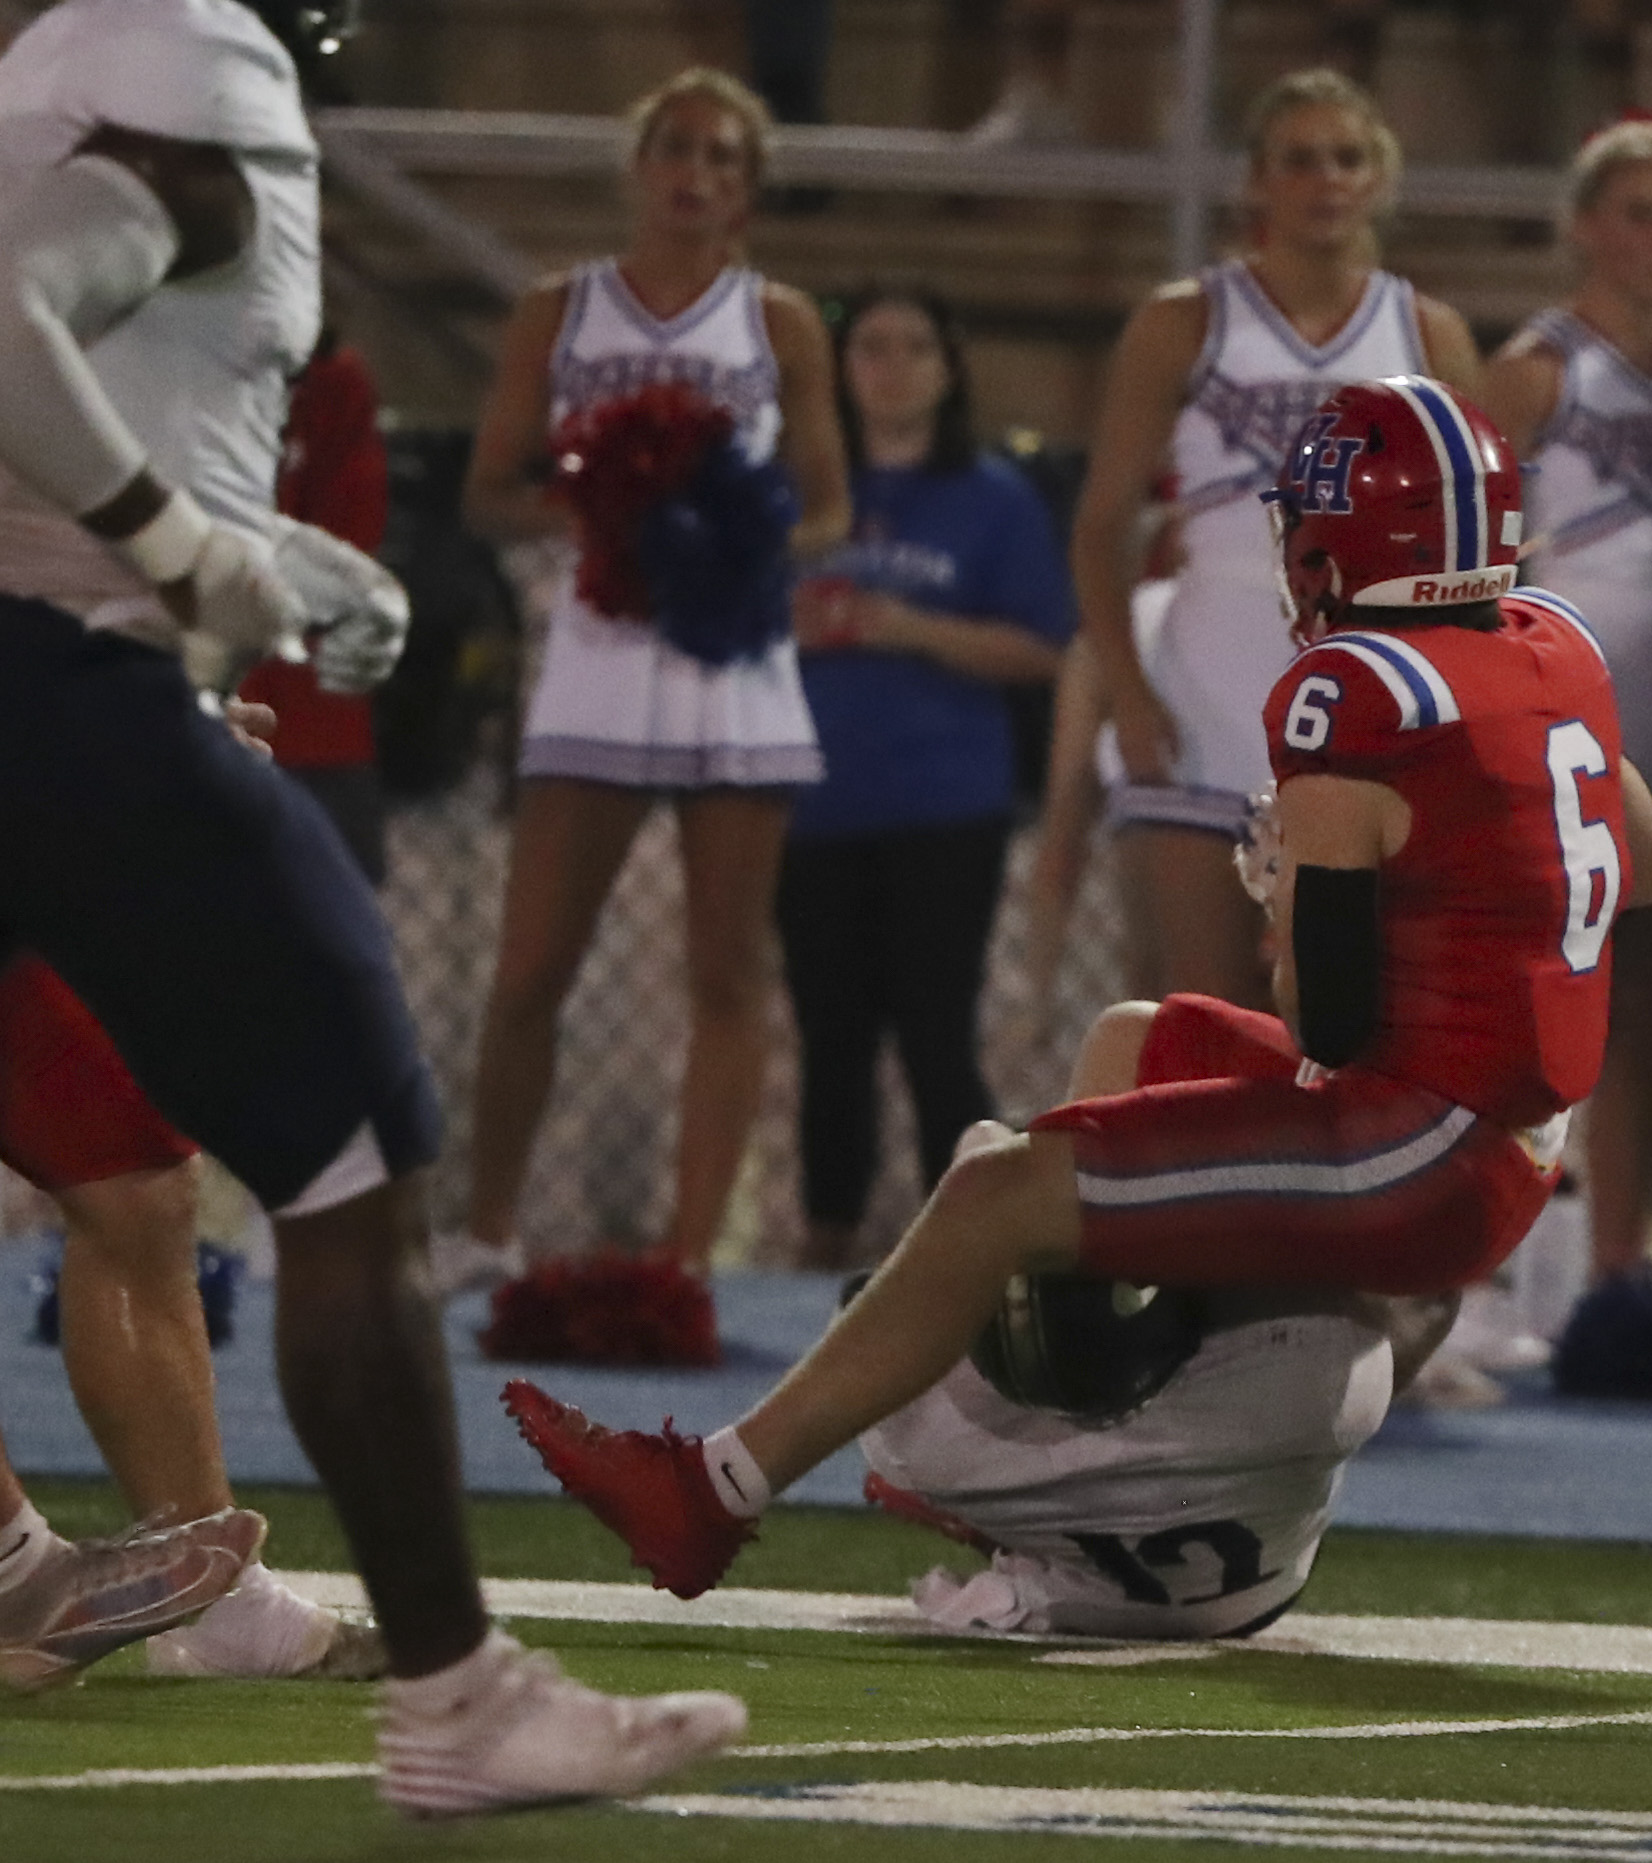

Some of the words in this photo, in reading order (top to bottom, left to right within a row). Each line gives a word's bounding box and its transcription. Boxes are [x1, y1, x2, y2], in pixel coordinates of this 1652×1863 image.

[1284, 674, 1342, 752] 6
[1547, 718, 1621, 975] 6
[1061, 1518, 1284, 1607] 12
